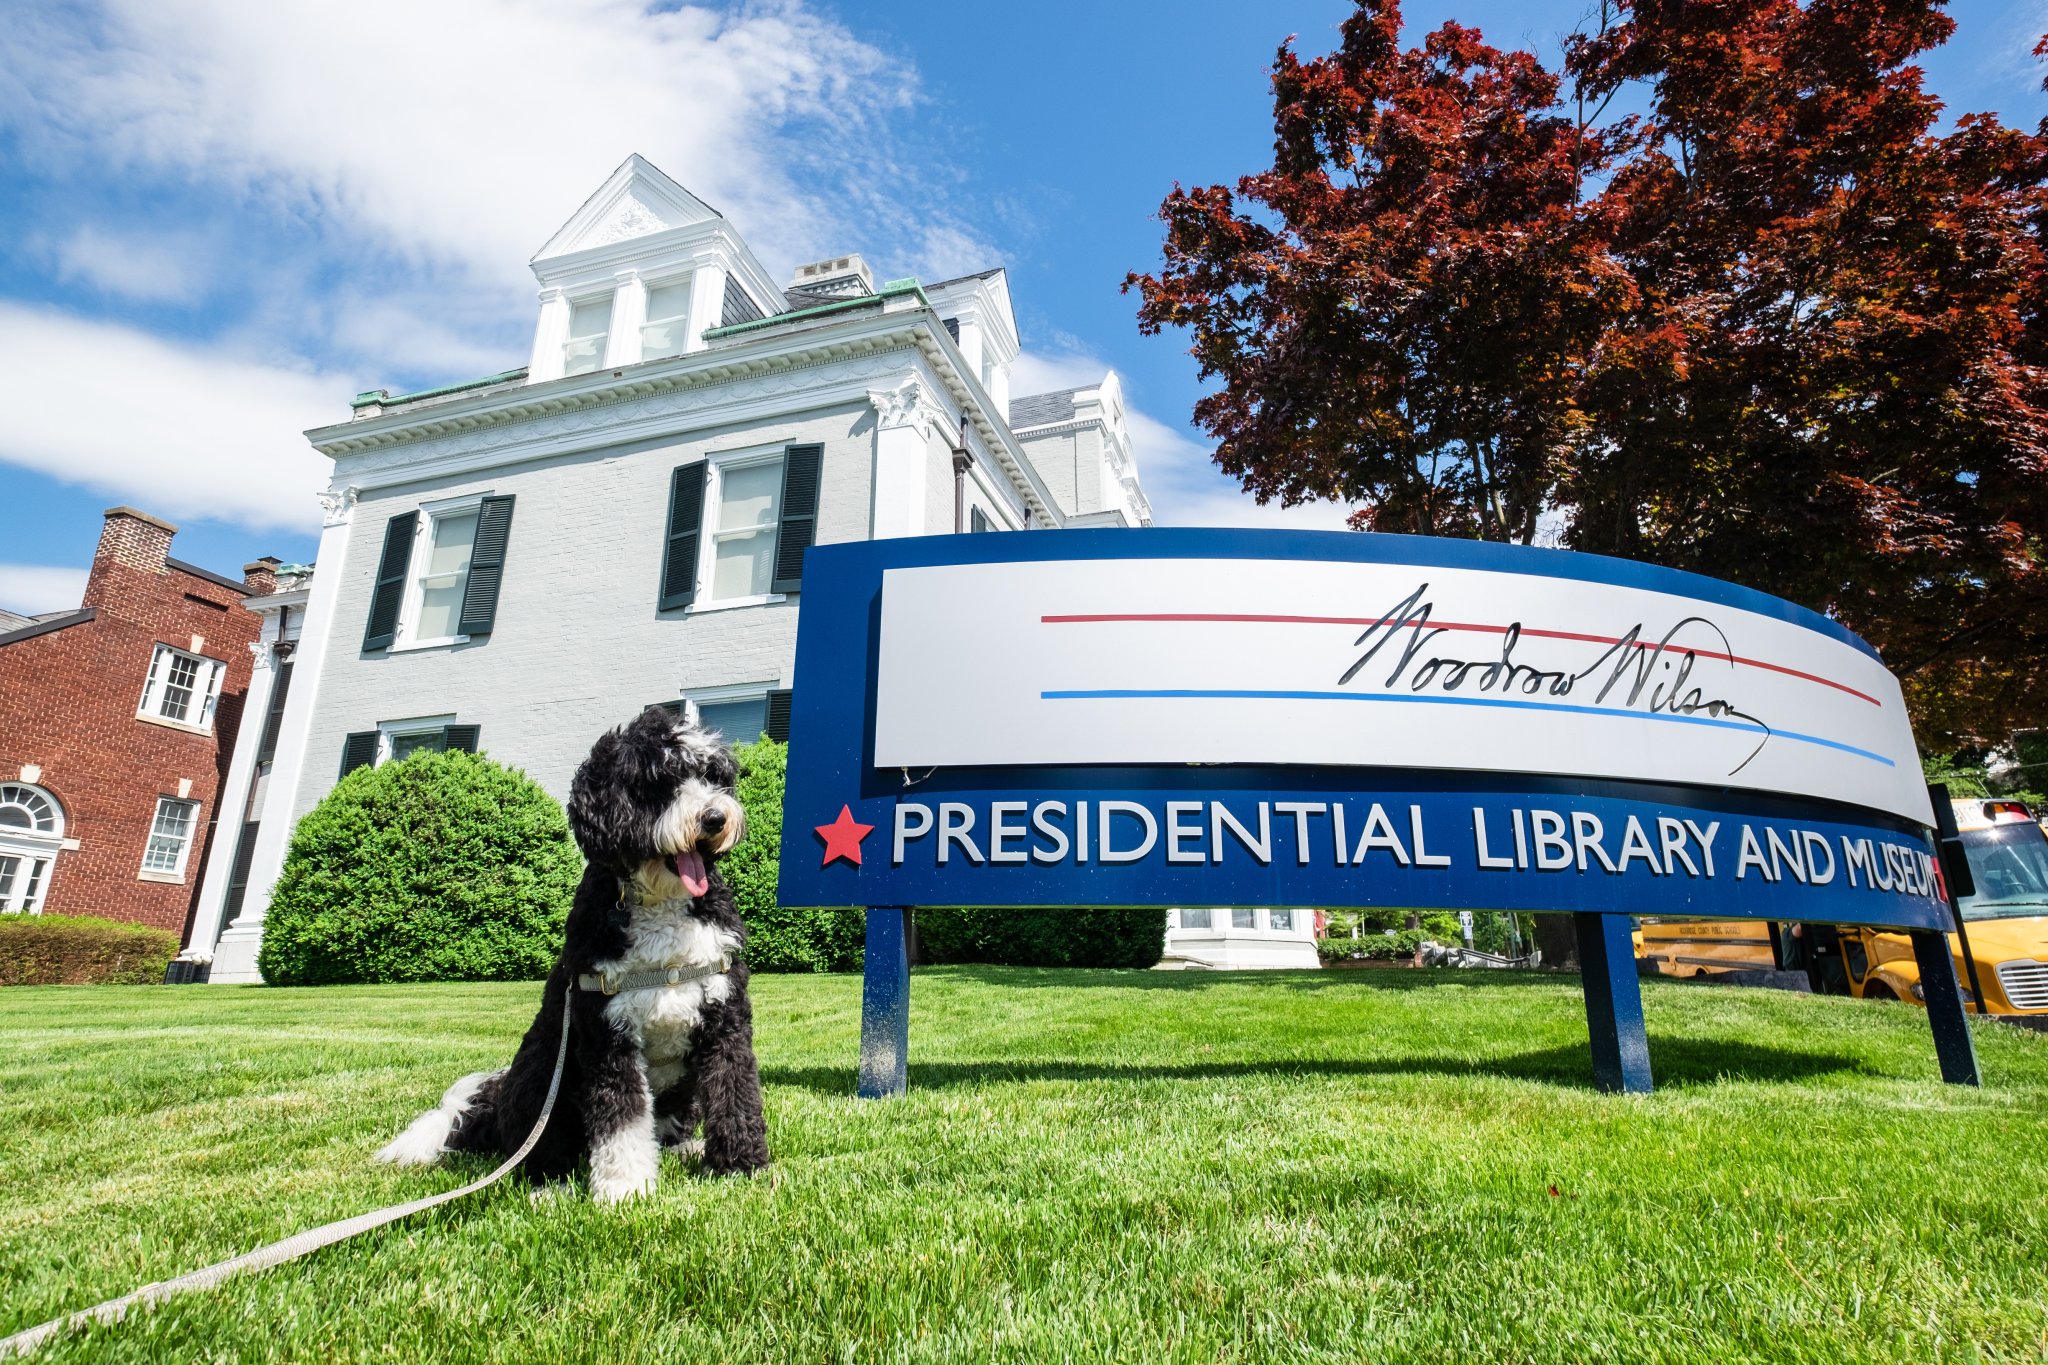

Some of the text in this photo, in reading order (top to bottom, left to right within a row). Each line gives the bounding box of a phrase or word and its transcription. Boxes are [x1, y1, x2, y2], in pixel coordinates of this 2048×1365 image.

[1338, 582, 1770, 777] Woodrow Wilson
[893, 801, 1940, 898] PRESIDENTIAL LIBRARY AND MUSEUM
